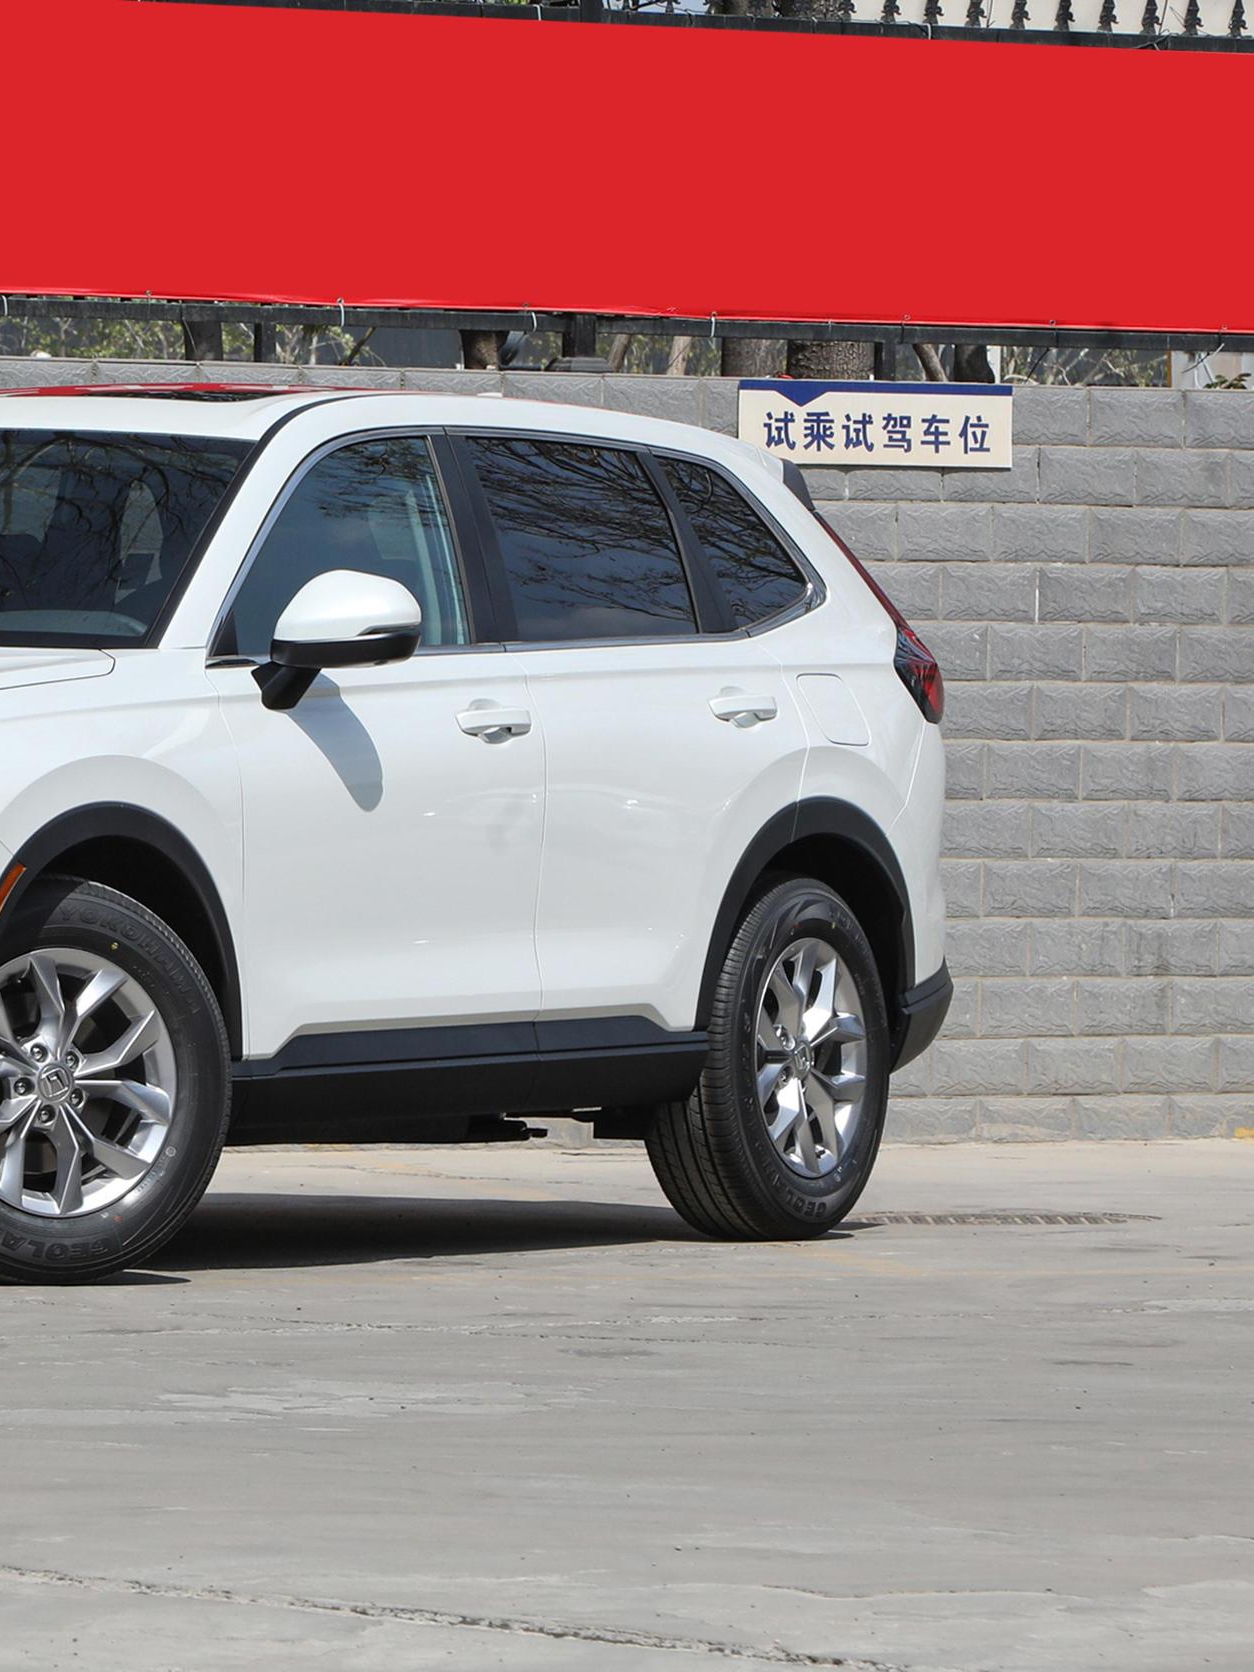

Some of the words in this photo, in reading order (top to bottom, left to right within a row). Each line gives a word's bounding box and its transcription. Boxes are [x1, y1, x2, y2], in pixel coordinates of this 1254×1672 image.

[763, 411, 991, 455] 试乘试驾车位
